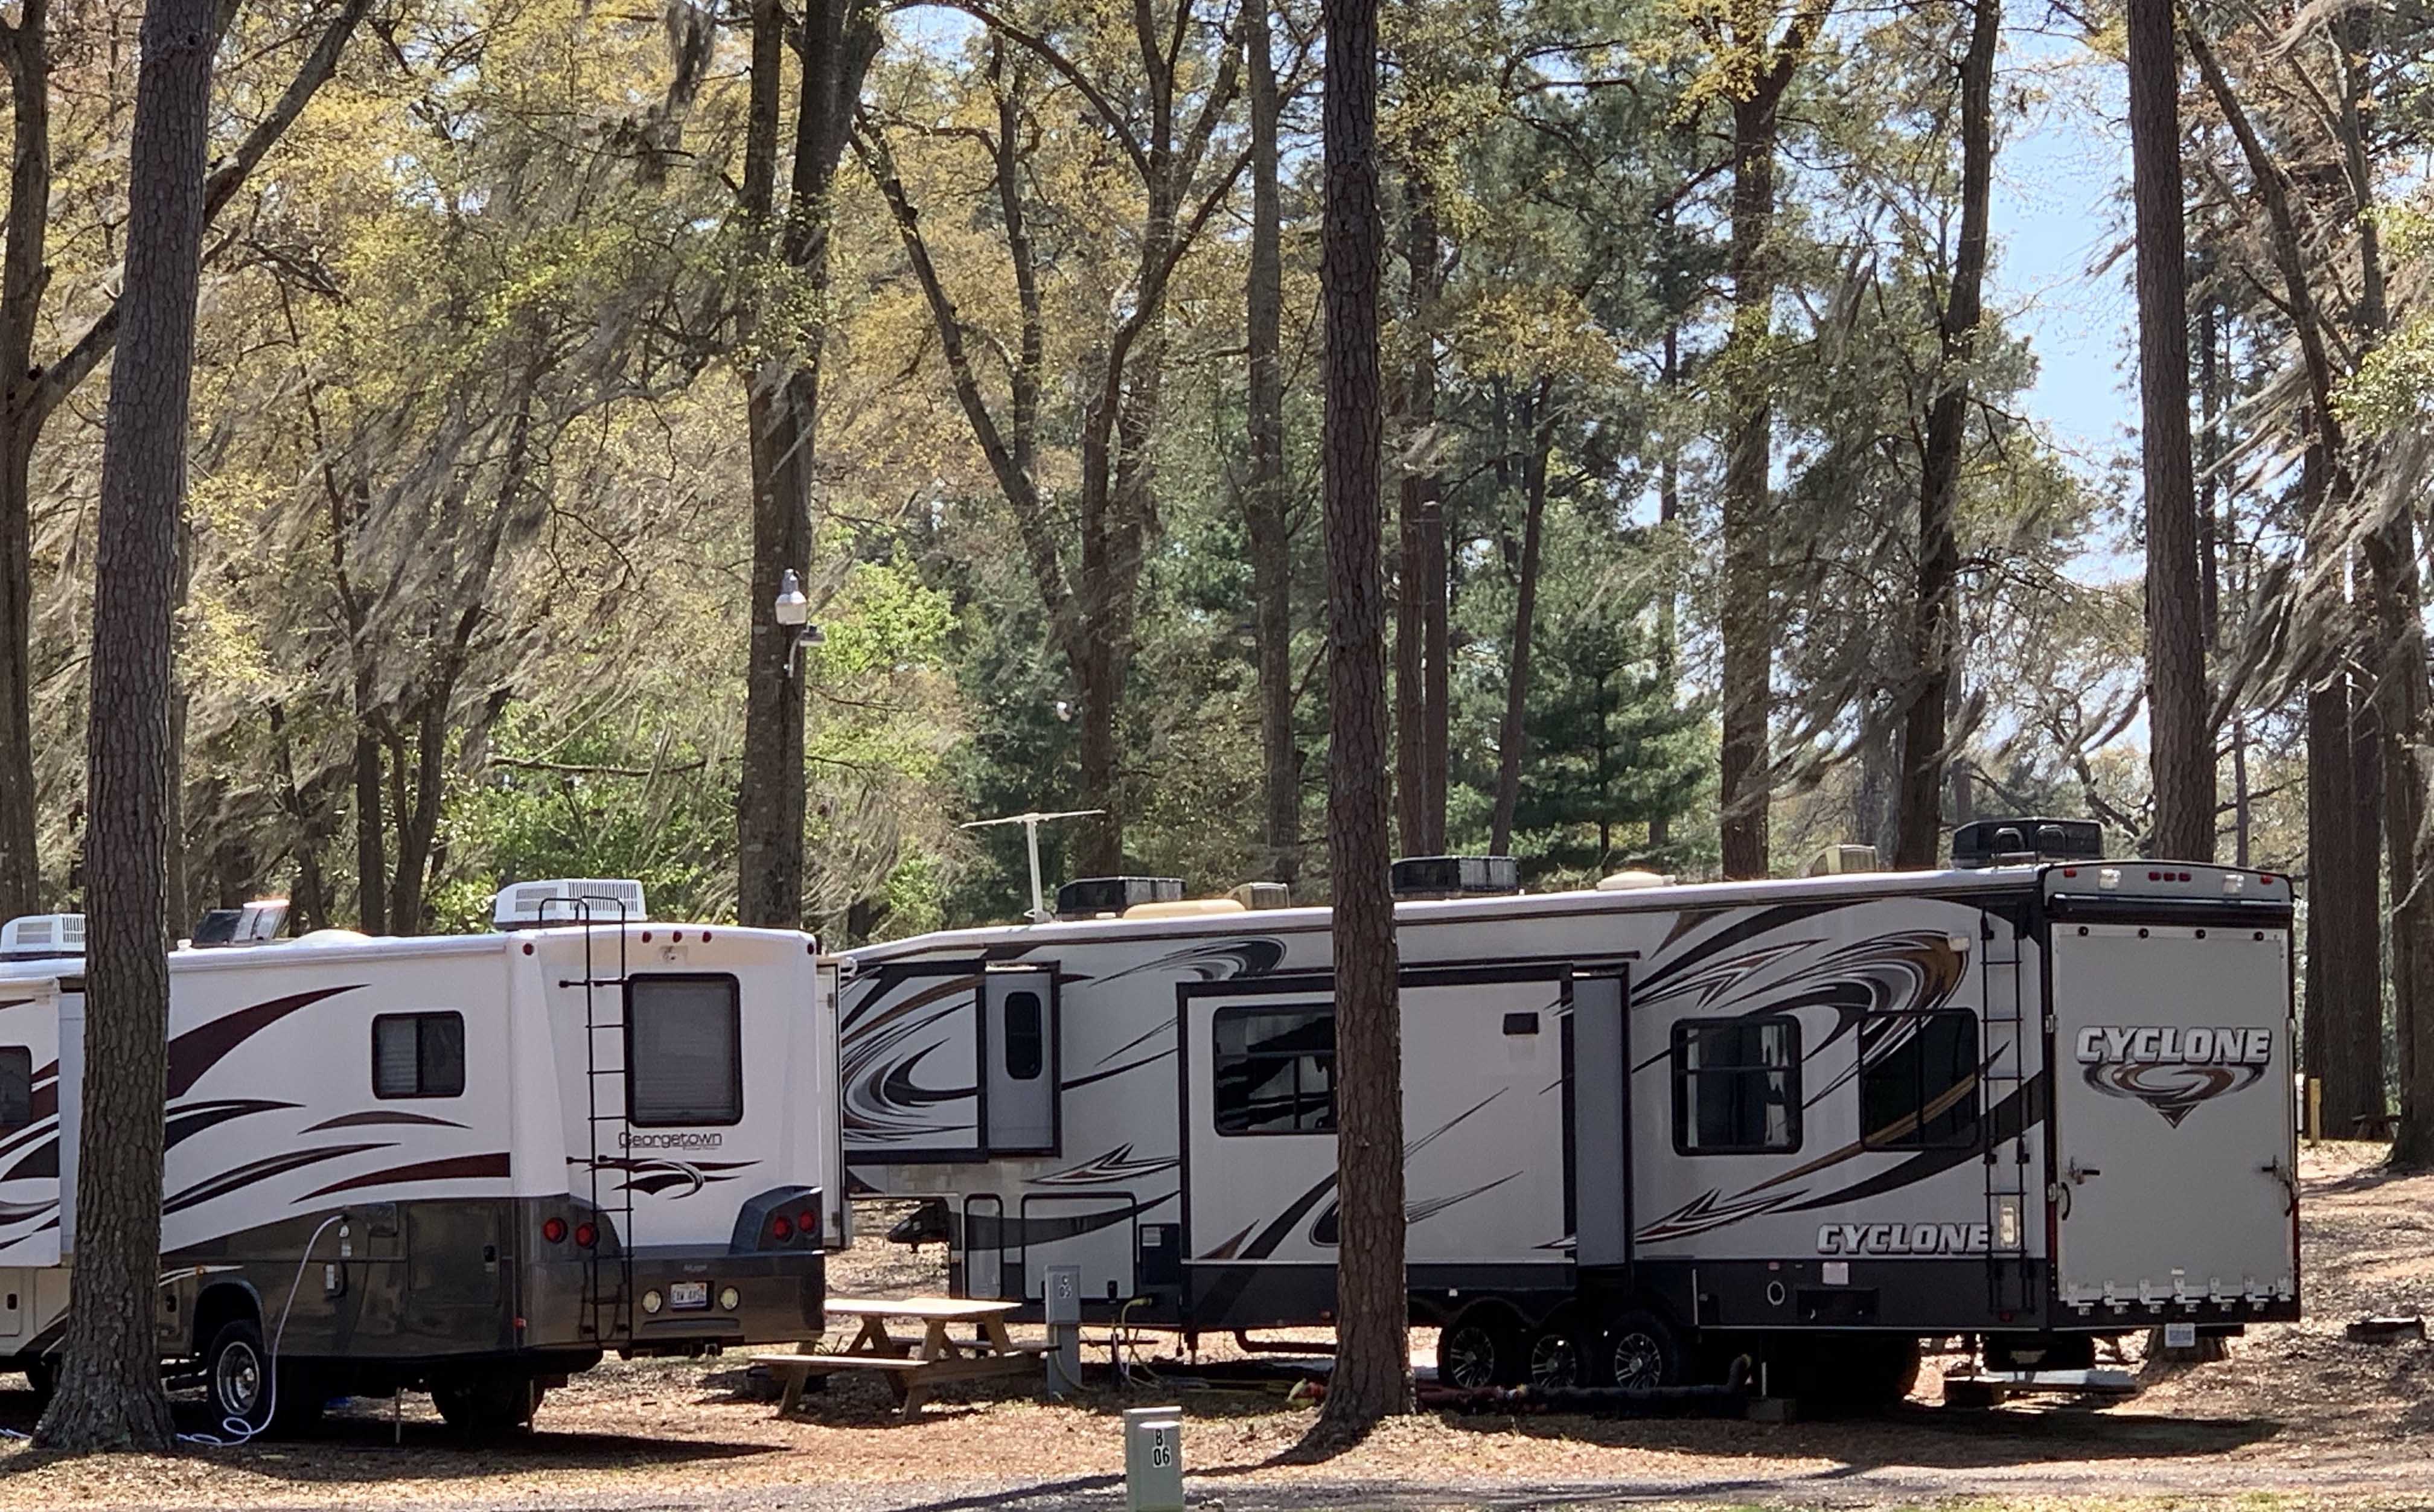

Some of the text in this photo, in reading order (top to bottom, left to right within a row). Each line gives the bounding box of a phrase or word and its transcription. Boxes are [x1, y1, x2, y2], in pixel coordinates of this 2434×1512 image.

[2075, 1026, 2272, 1065] CYCLONE
[619, 1132, 722, 1148] Georgetown
[1817, 1223, 1990, 1254] CYCLONE
[1155, 1429, 1163, 1446] B
[1154, 1447, 1170, 1466] 06
